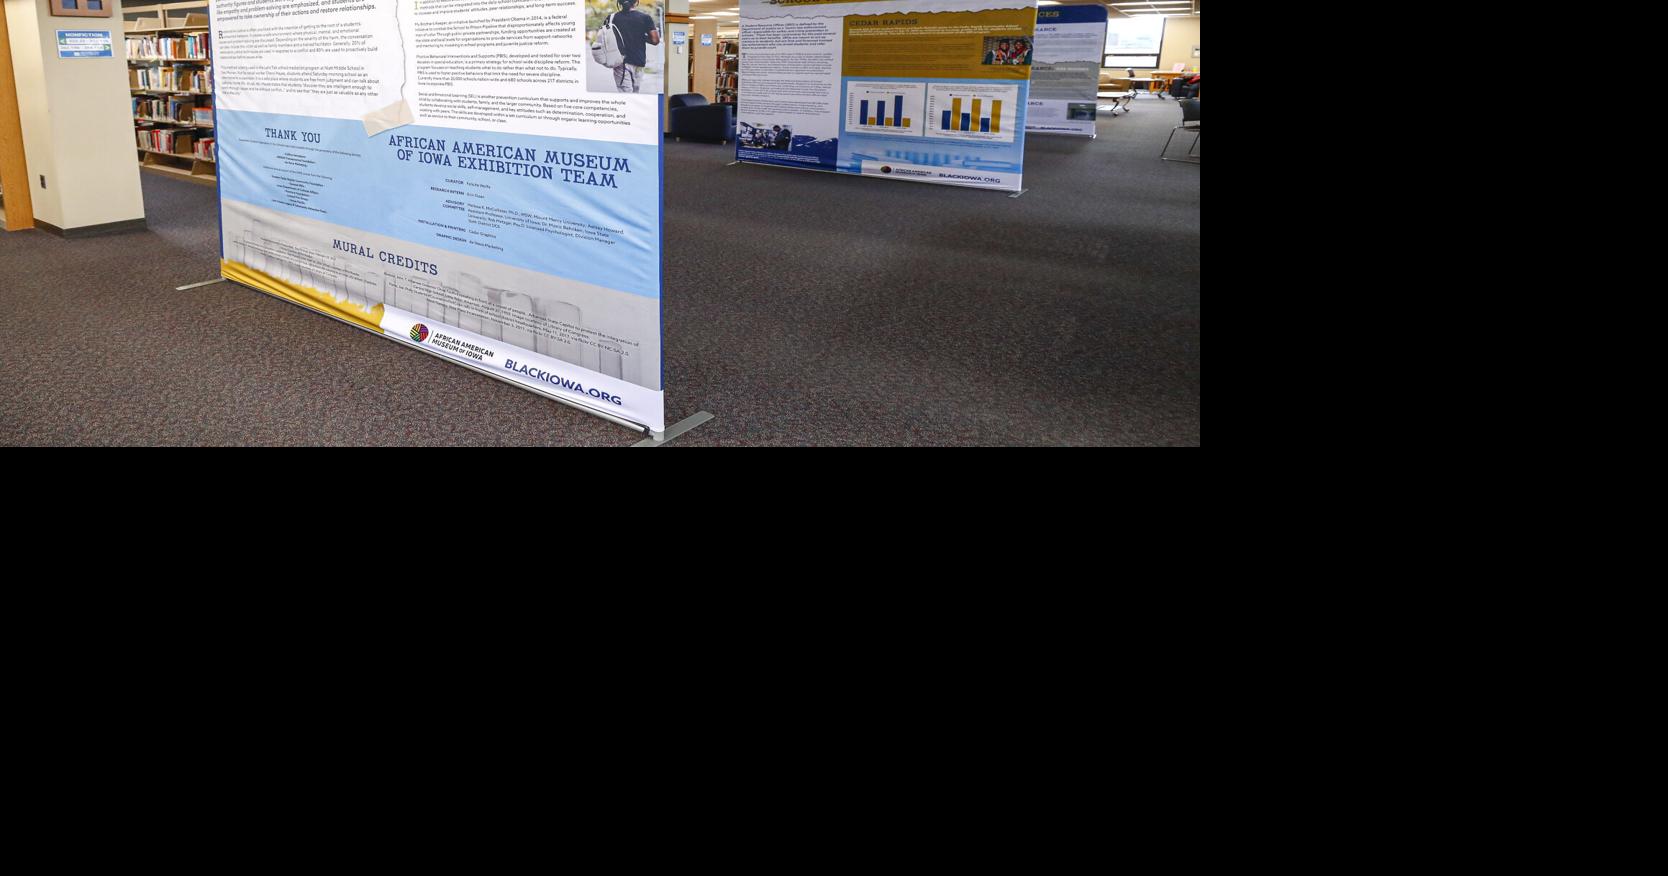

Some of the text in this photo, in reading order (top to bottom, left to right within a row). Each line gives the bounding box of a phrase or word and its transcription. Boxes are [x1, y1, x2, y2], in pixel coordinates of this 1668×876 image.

[264, 127, 321, 144] THANK YOU
[388, 134, 632, 174] AFRICAN AMERICAN MUSEUM
[397, 149, 618, 190] OF IOWA EXHIBITION TEAM
[938, 172, 1001, 185] BLACKIOWA.ORG
[332, 238, 374, 260] MURAL
[378, 250, 439, 277] CREDITS
[431, 338, 459, 353] MUSEUM
[465, 350, 483, 362] IOWA
[434, 332, 495, 359] AFRICAN AMERICAN
[504, 358, 623, 407] BLACKIOWA.ORG
